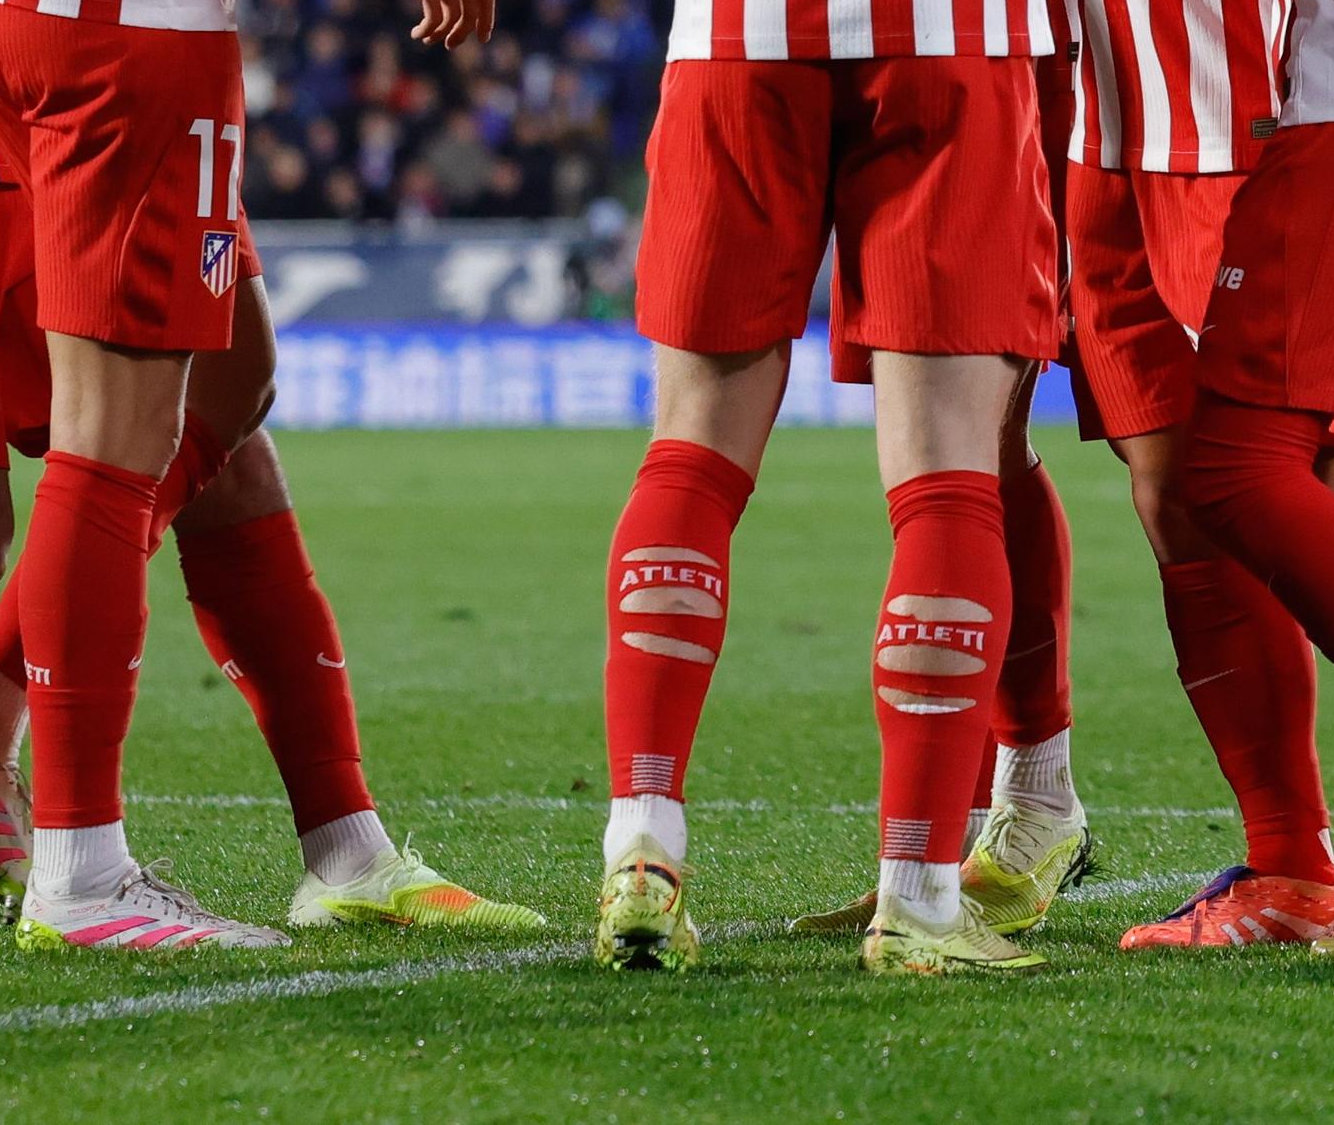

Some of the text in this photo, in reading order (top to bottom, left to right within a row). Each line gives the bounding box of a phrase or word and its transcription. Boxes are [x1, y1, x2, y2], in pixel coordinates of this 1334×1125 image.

[1216, 263, 1245, 290] ve
[619, 565, 722, 599] ATLETI
[877, 622, 985, 652] ATLETI
